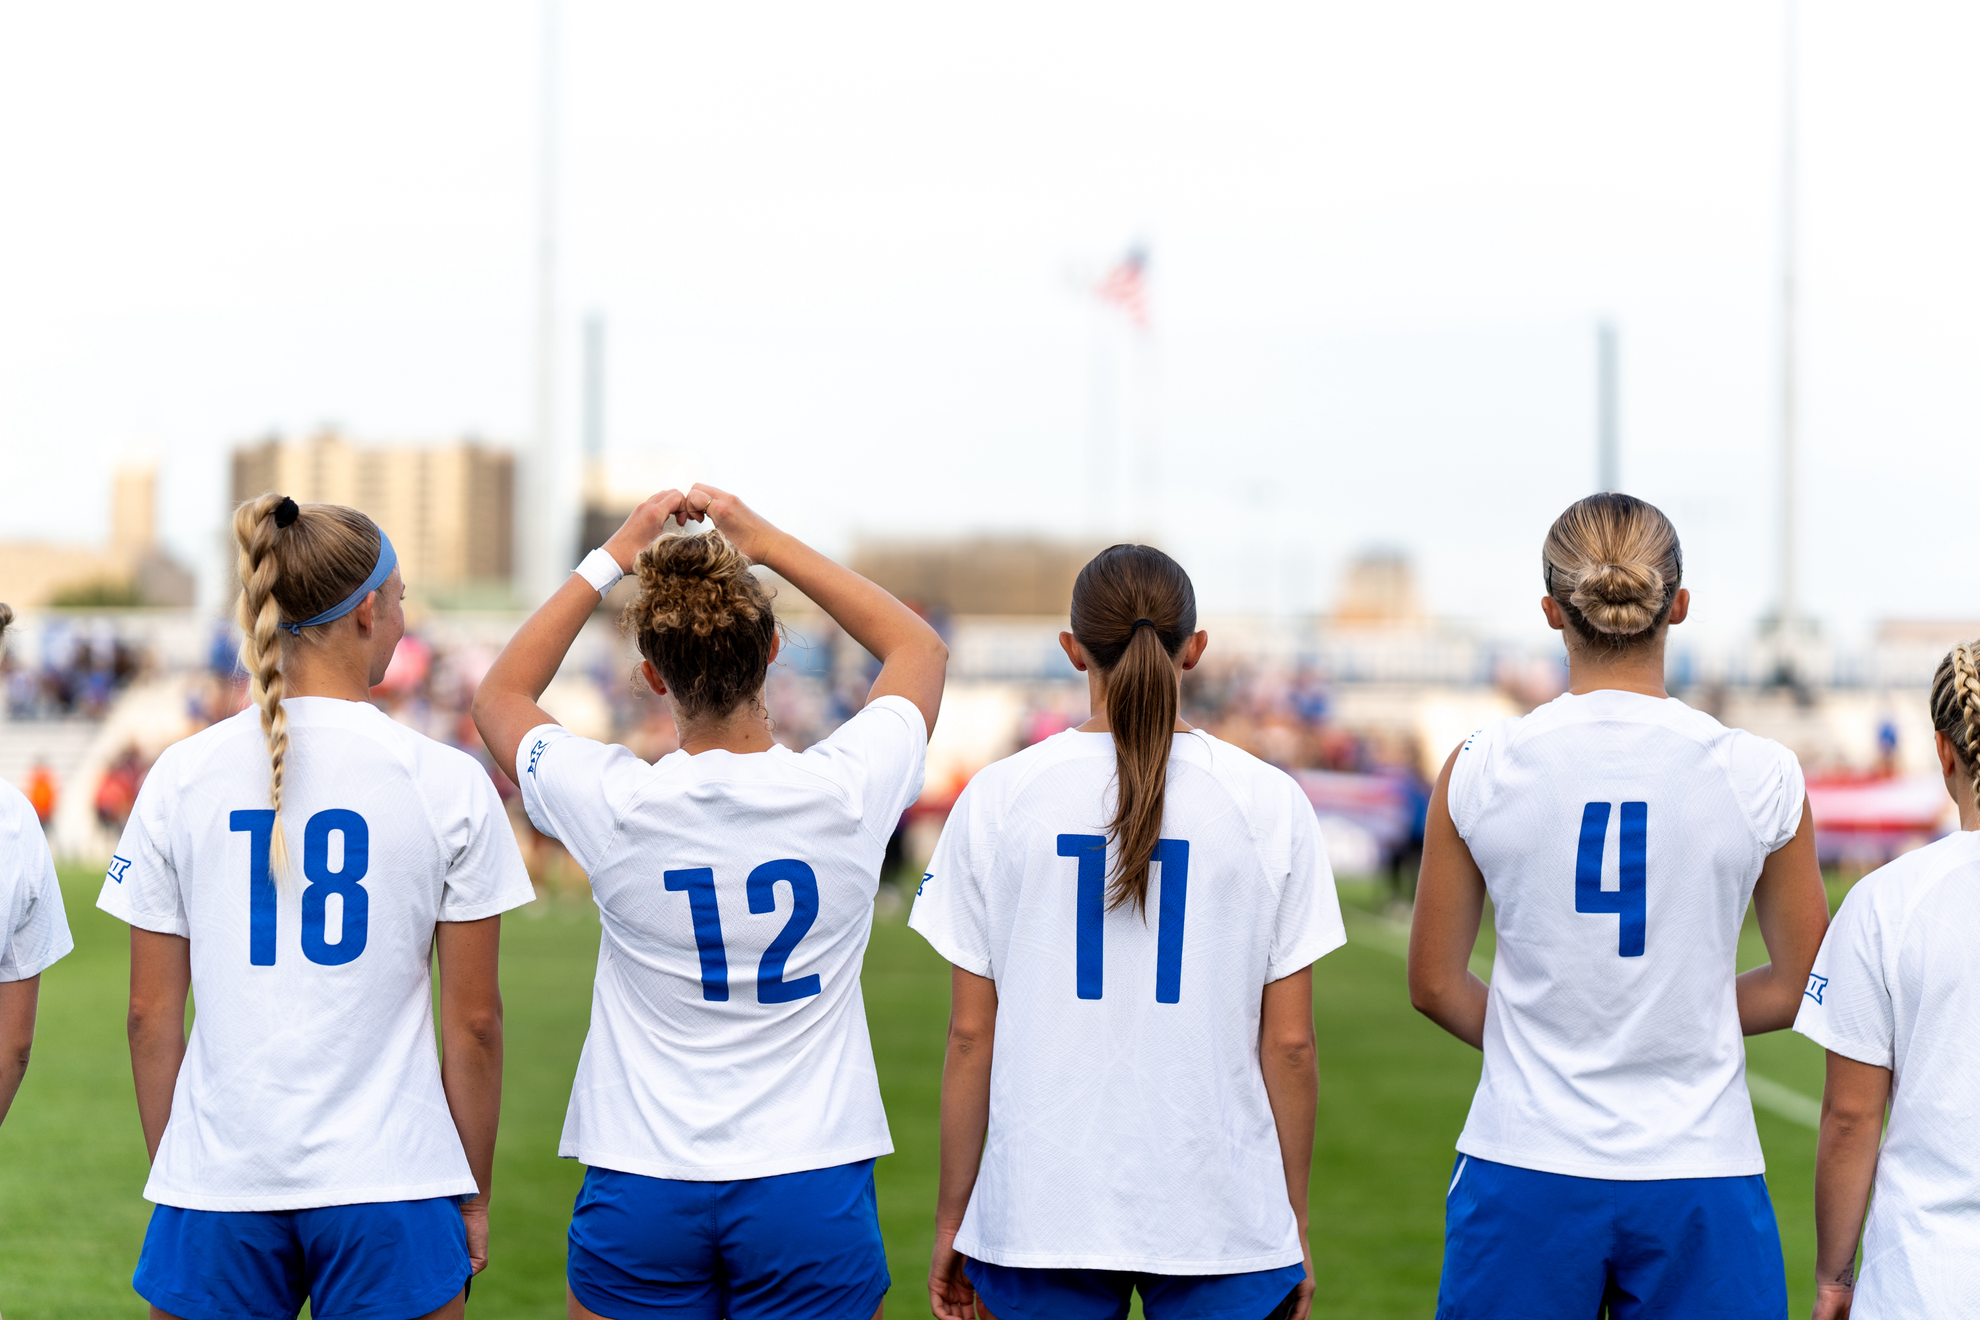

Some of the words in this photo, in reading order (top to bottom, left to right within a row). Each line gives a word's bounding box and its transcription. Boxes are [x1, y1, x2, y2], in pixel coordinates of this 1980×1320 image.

[229, 809, 369, 966] 18
[663, 859, 822, 1005] 12
[1057, 834, 1190, 1004] 11
[1575, 802, 1648, 958] 4
